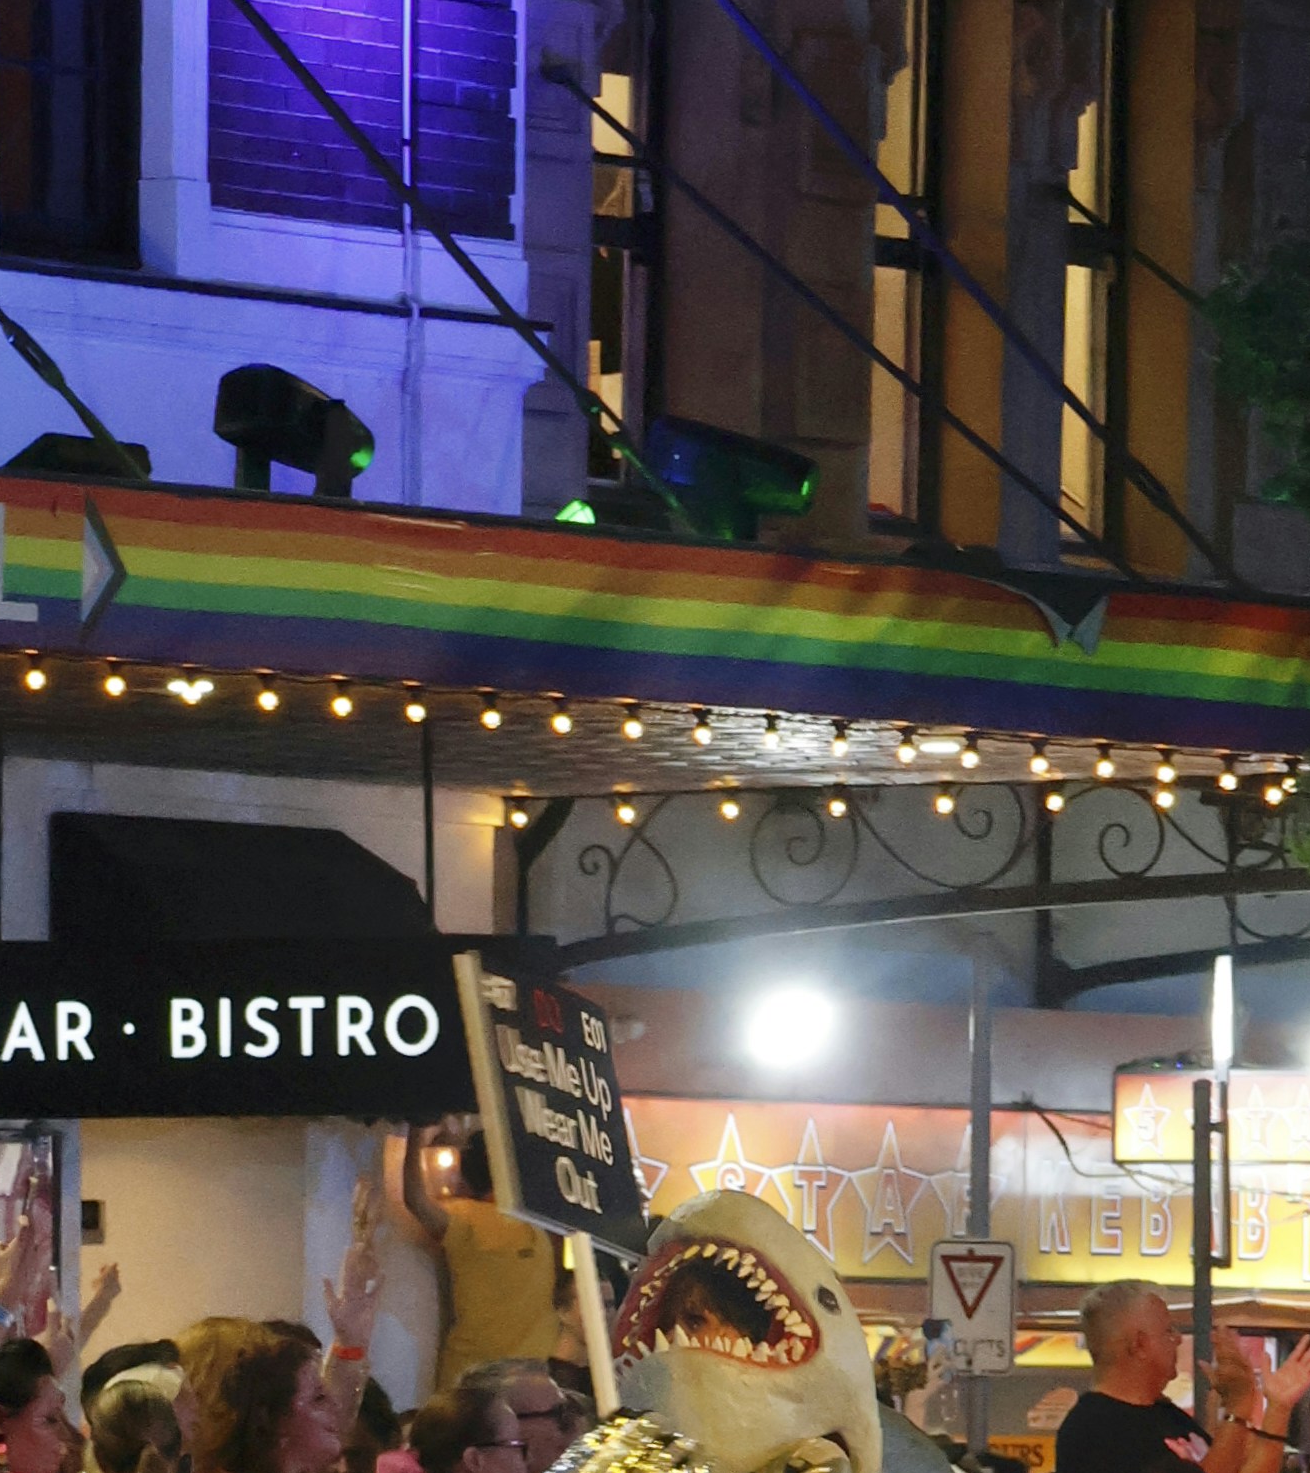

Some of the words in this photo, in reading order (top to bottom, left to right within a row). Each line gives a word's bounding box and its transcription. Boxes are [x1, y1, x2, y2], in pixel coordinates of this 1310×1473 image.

[170, 994, 441, 1060] BISTRO
[496, 1024, 548, 1083] Use
[542, 1041, 583, 1100] Me
[580, 1057, 612, 1121] Up
[515, 1085, 579, 1151] Wear
[577, 1109, 614, 1167] Me
[555, 1156, 604, 1215] Out
[1038, 1160, 1271, 1261] KEBB
